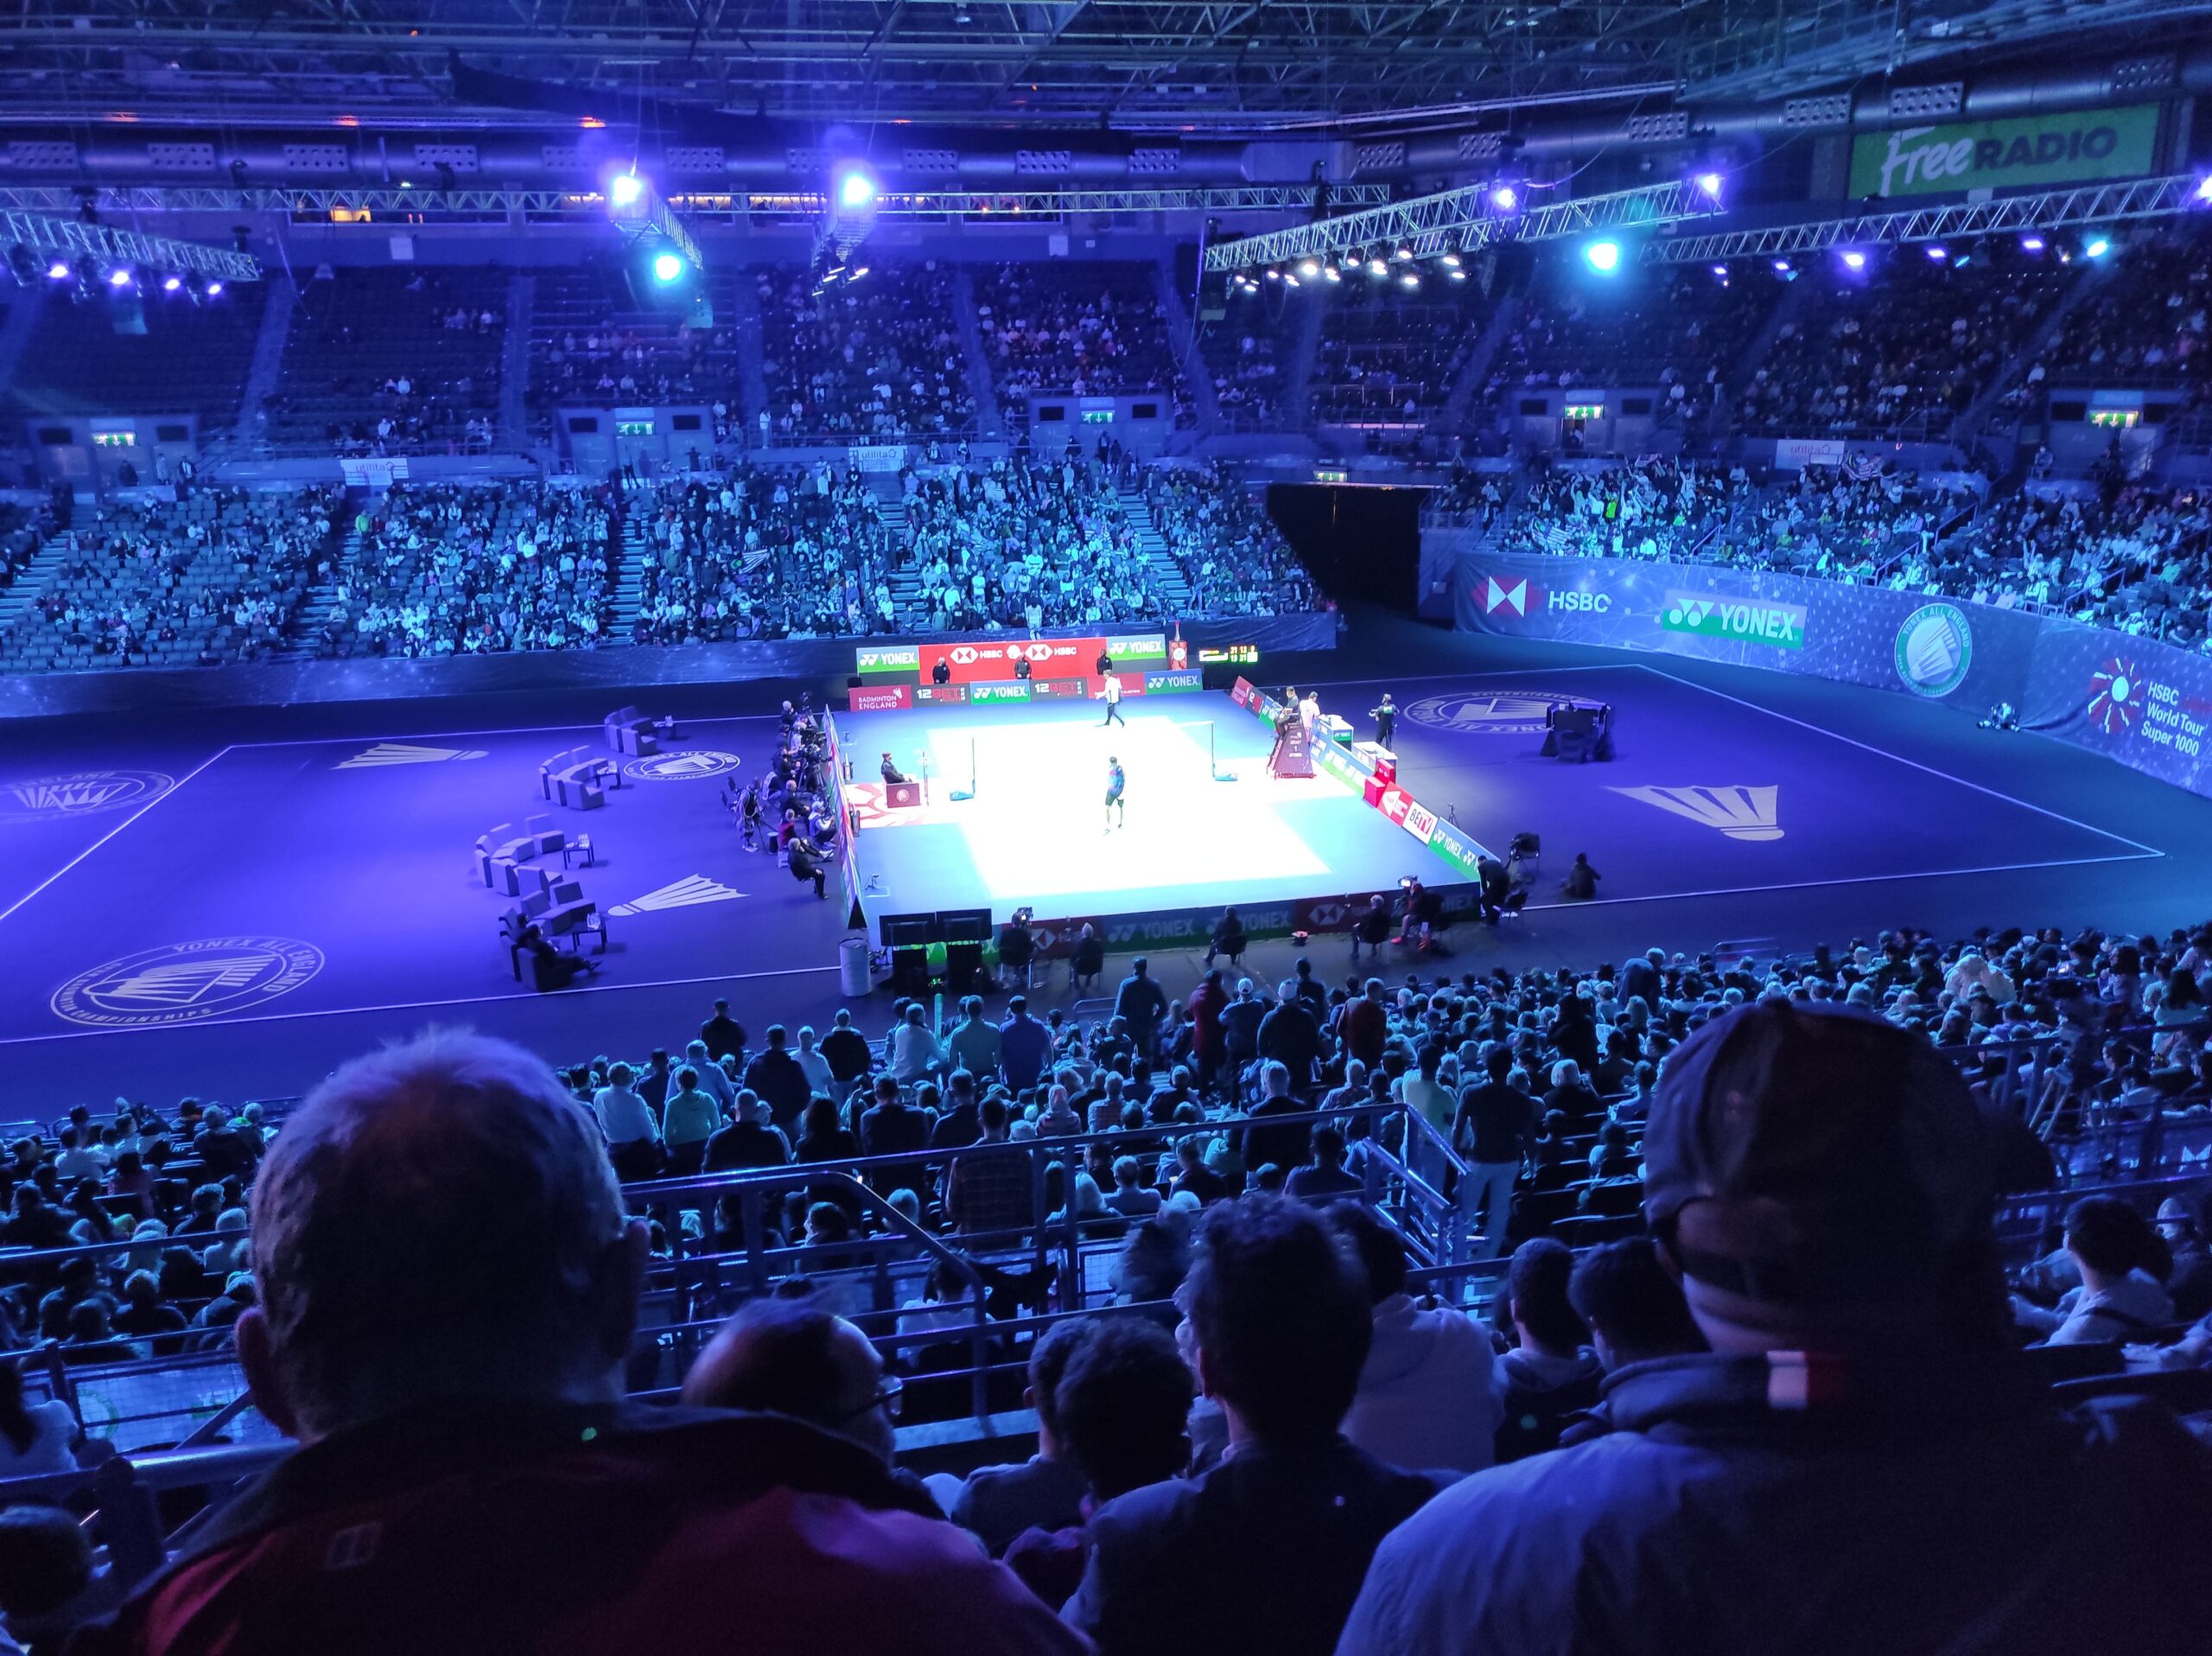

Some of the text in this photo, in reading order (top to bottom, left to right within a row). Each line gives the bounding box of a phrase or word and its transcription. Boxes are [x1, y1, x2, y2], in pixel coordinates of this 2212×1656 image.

[1880, 126, 2117, 198] Free RADIO
[1548, 590, 1610, 614] HSBC
[1719, 602, 1798, 641] YONEX
[1903, 607, 1970, 647] YONEX ALL ENGLAND
[881, 652, 916, 665] YONEX
[1129, 641, 1161, 653] YONEX
[994, 686, 1027, 697] YONEX
[1167, 676, 1198, 687] YONEX
[2148, 680, 2179, 706] HSBC
[859, 702, 898, 710] ENGLAND
[2147, 701, 2204, 737] World Tour
[2141, 720, 2200, 756] Super 1000
[1443, 834, 1464, 859] YONEX
[1141, 919, 1194, 939] YONEX
[174, 939, 317, 992] YONEX ALL ENGLAND
